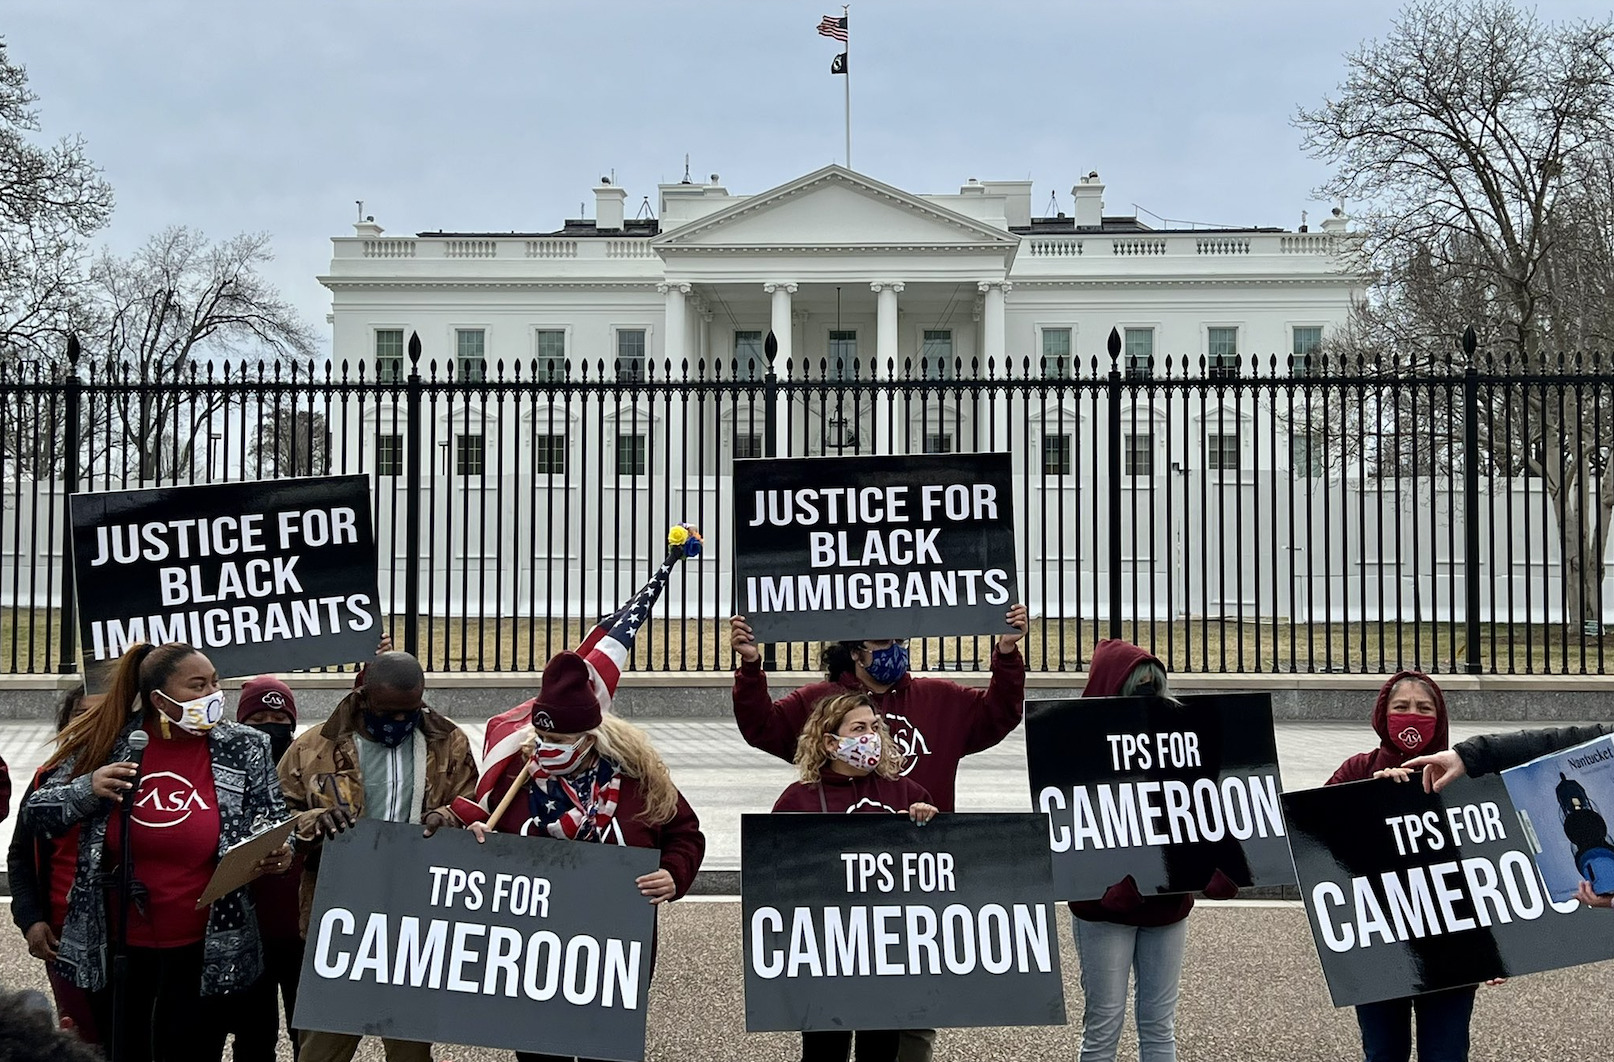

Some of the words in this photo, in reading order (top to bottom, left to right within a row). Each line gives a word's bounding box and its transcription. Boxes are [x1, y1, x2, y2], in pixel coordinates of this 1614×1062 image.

[749, 486, 909, 527] JUSTICE
[921, 483, 999, 522] FOR
[91, 513, 266, 567] JUSTICE
[277, 506, 359, 550] FOR
[809, 527, 943, 568] BLACK
[159, 555, 304, 607] BLACK
[746, 568, 1010, 613] IMMIGRANTS
[91, 593, 374, 661] IMMIGRANTS
[1106, 732, 1153, 772] TPS
[1155, 731, 1202, 769] FOR
[1567, 746, 1614, 770] Nantucket
[134, 787, 211, 812] ASA
[1039, 775, 1286, 854] CAMEROON
[1385, 810, 1445, 857] TPS
[1445, 801, 1507, 847] FOR
[428, 865, 486, 911] TPS
[491, 873, 551, 918] FOR
[840, 852, 895, 893] TPS
[901, 851, 956, 893] FOR
[1312, 850, 1582, 954] CAMERO
[313, 907, 642, 1010] CAMEROON
[751, 903, 1052, 979] CAMEROON
